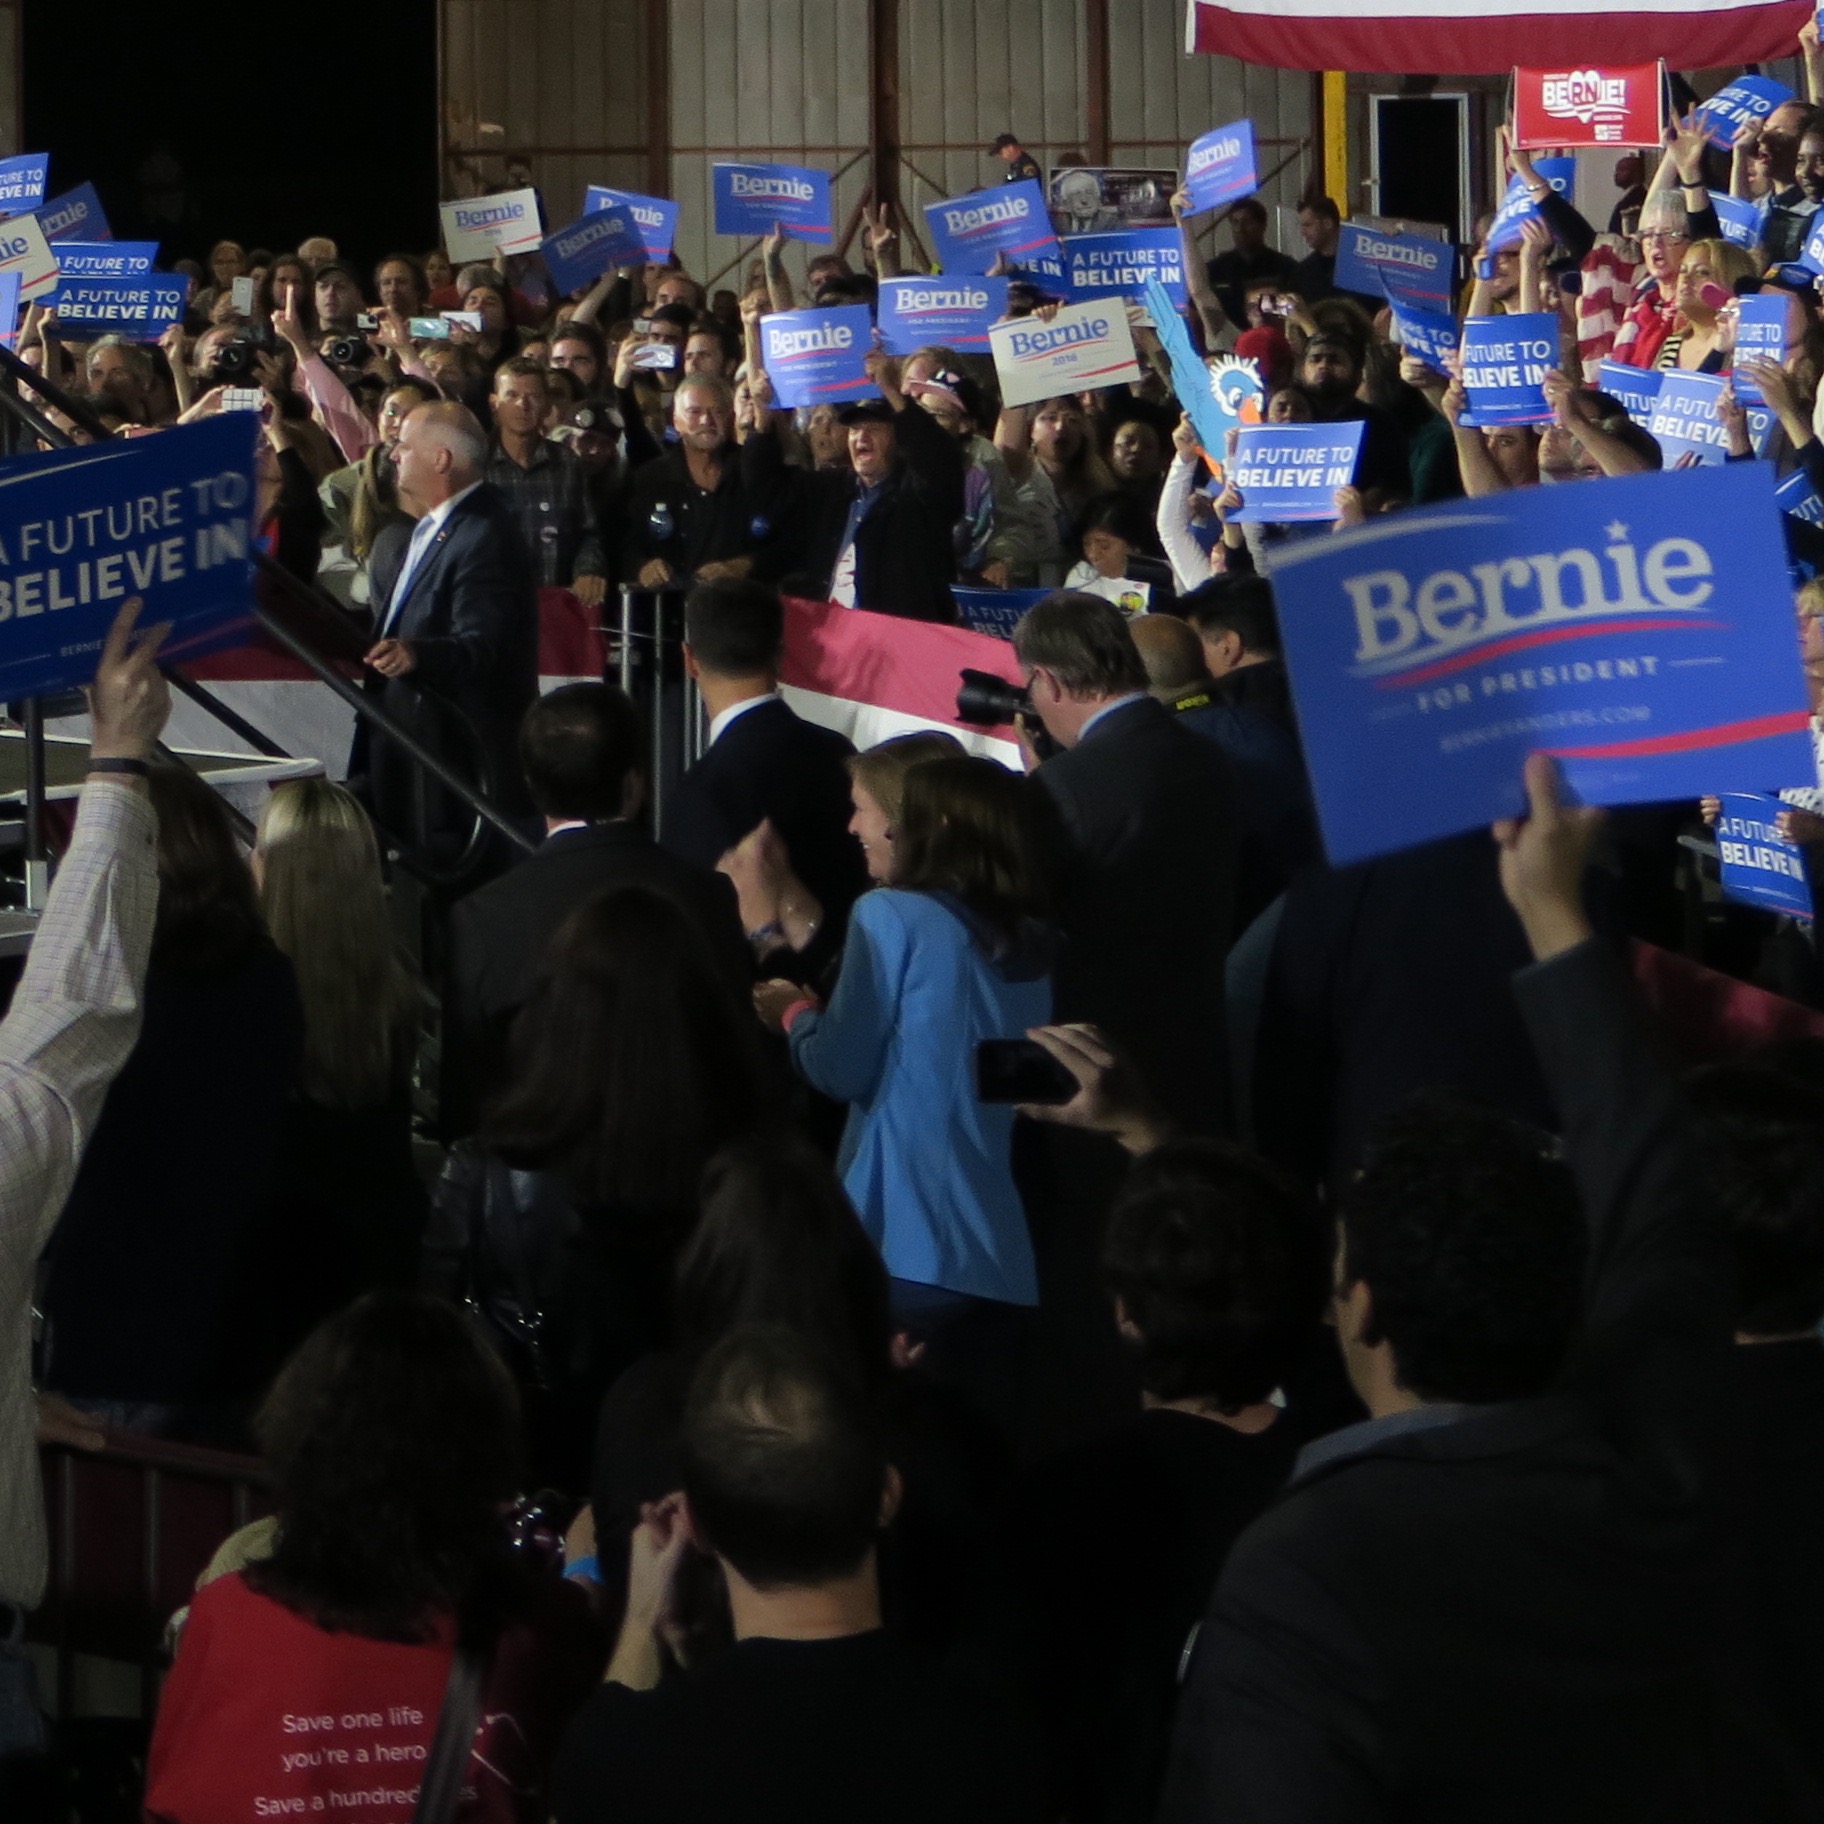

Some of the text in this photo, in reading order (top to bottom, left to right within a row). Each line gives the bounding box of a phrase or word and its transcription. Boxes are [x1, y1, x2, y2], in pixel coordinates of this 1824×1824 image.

[25, 184, 43, 198] IN
[730, 172, 815, 203] Bernie
[455, 201, 524, 228] Bernie
[944, 195, 1030, 231] Bernie
[556, 217, 625, 259] Bernie
[1353, 234, 1439, 270] Bernie
[1073, 248, 1179, 267] A FUTURE TO
[62, 288, 181, 304] A FUTURE TO
[895, 285, 989, 312] Bernie
[57, 303, 179, 320] BELIEVE IN
[769, 324, 852, 354] Bernie
[1009, 316, 1110, 358] Bernie
[1052, 352, 1078, 366] 2016
[1241, 446, 1352, 464] A FUTURE TO
[1238, 467, 1350, 488] BELIEVE IN
[20, 487, 183, 562] FUTURE
[192, 470, 250, 516] TO
[194, 516, 248, 571] IN
[1344, 518, 1715, 662] Bernie
[1417, 655, 1660, 715] FOR PRESIDENT
[283, 1706, 423, 1735] Save one life
[281, 1744, 427, 1772] you're a hero
[253, 1794, 306, 1817] Save
[311, 1794, 323, 1811] a
